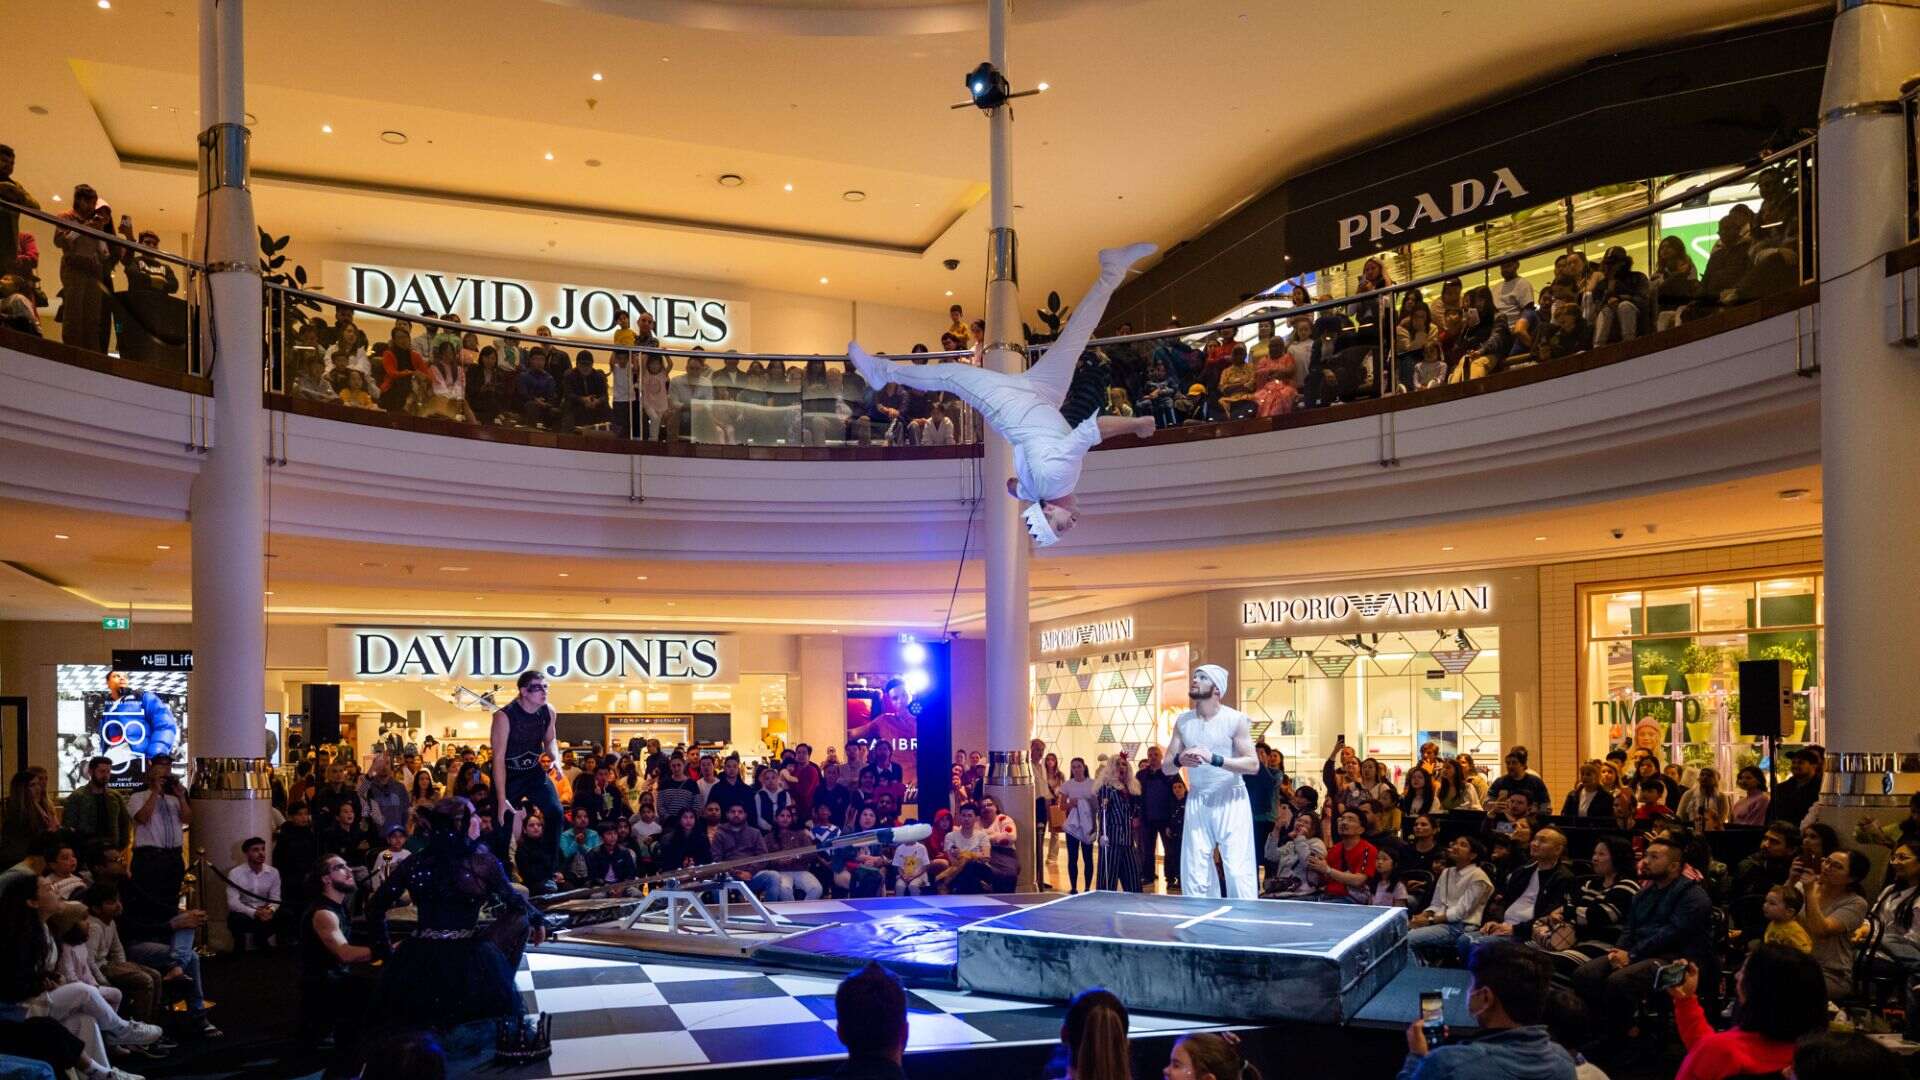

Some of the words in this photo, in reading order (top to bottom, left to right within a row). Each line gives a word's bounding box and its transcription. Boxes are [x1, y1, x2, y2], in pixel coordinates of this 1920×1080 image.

[1338, 167, 1529, 251] PRADA
[351, 266, 533, 323] DAVID
[550, 287, 728, 342] JONES
[1243, 595, 1349, 624] EMPORIO
[1386, 586, 1488, 615] ARMANI
[1040, 629, 1080, 651] EMPORIO
[1092, 618, 1132, 642] ARMANI
[355, 634, 530, 675] DAVID
[547, 637, 718, 679] JONES
[857, 738, 918, 751] AIBR
